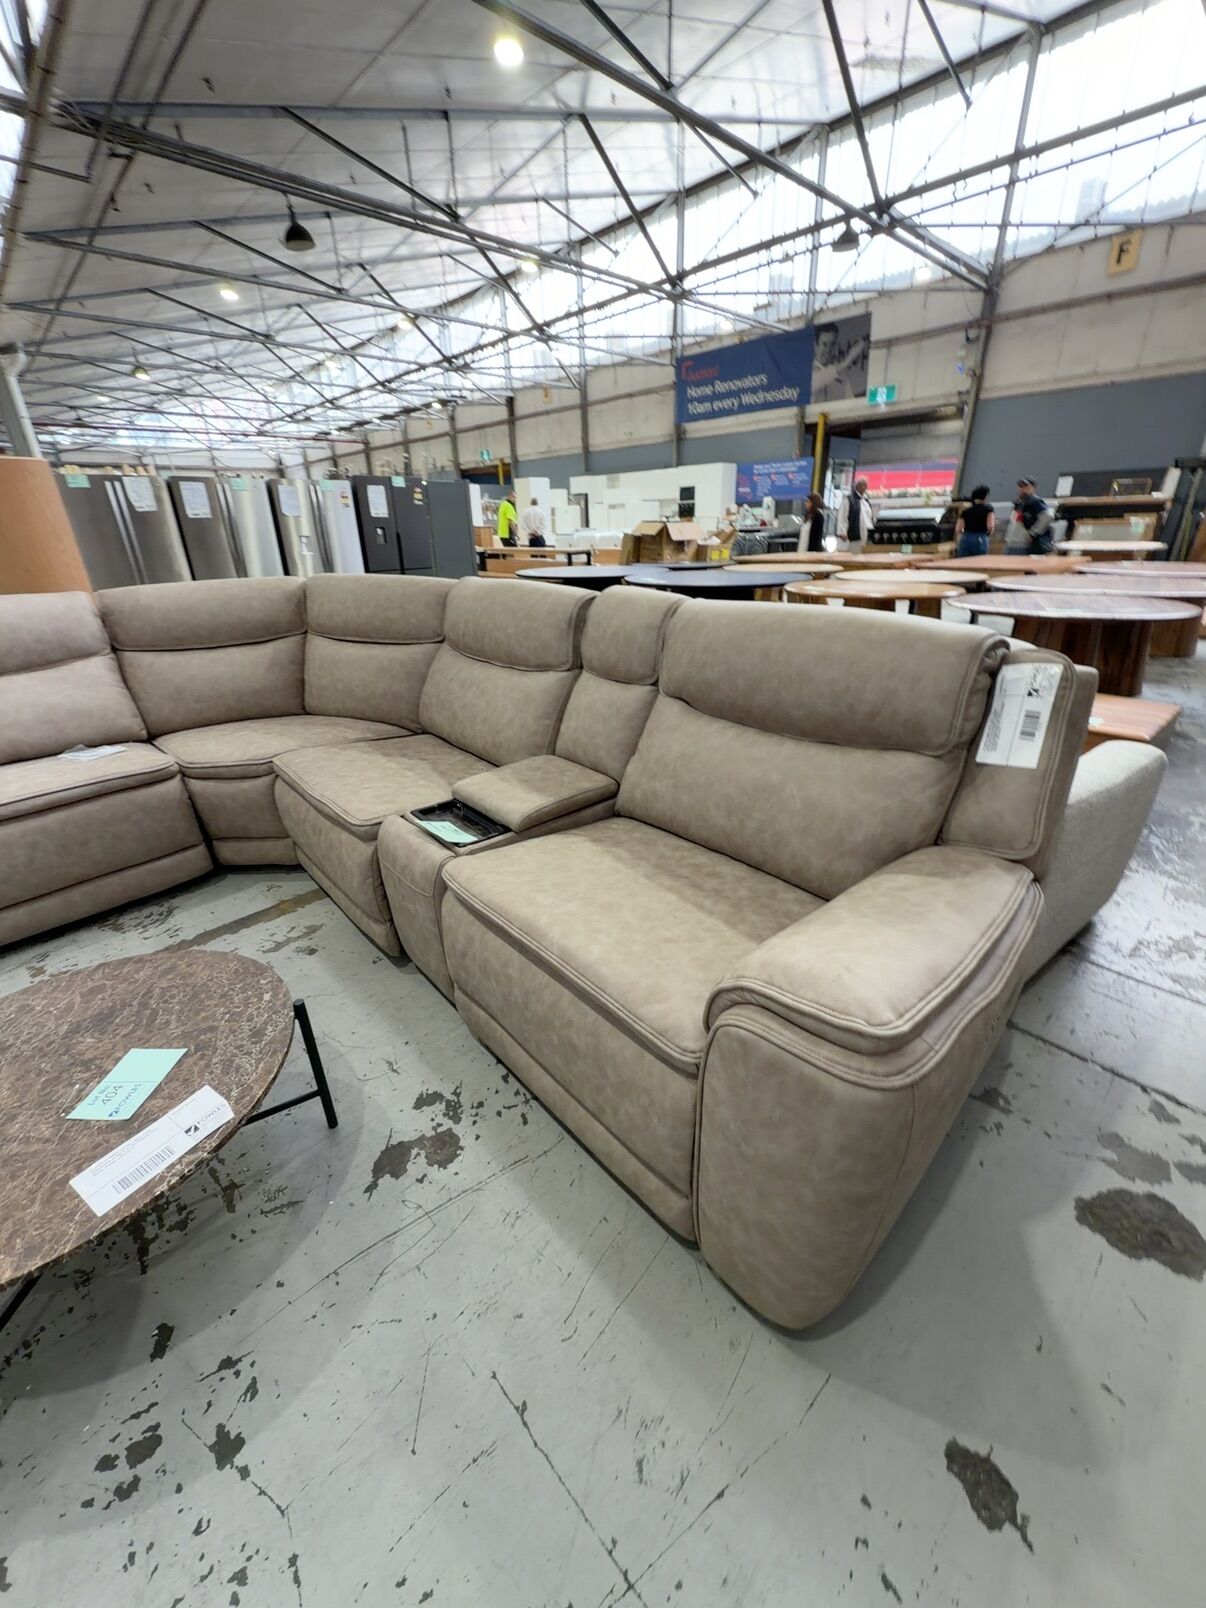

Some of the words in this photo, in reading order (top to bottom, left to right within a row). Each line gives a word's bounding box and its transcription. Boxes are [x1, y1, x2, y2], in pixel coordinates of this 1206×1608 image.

[1116, 238, 1132, 264] F
[686, 385, 713, 399] Home
[714, 373, 767, 394] Renovators
[687, 400, 713, 416] 10am
[712, 396, 740, 412] every
[740, 384, 800, 406] Wednesday
[101, 1085, 124, 1106] 404
